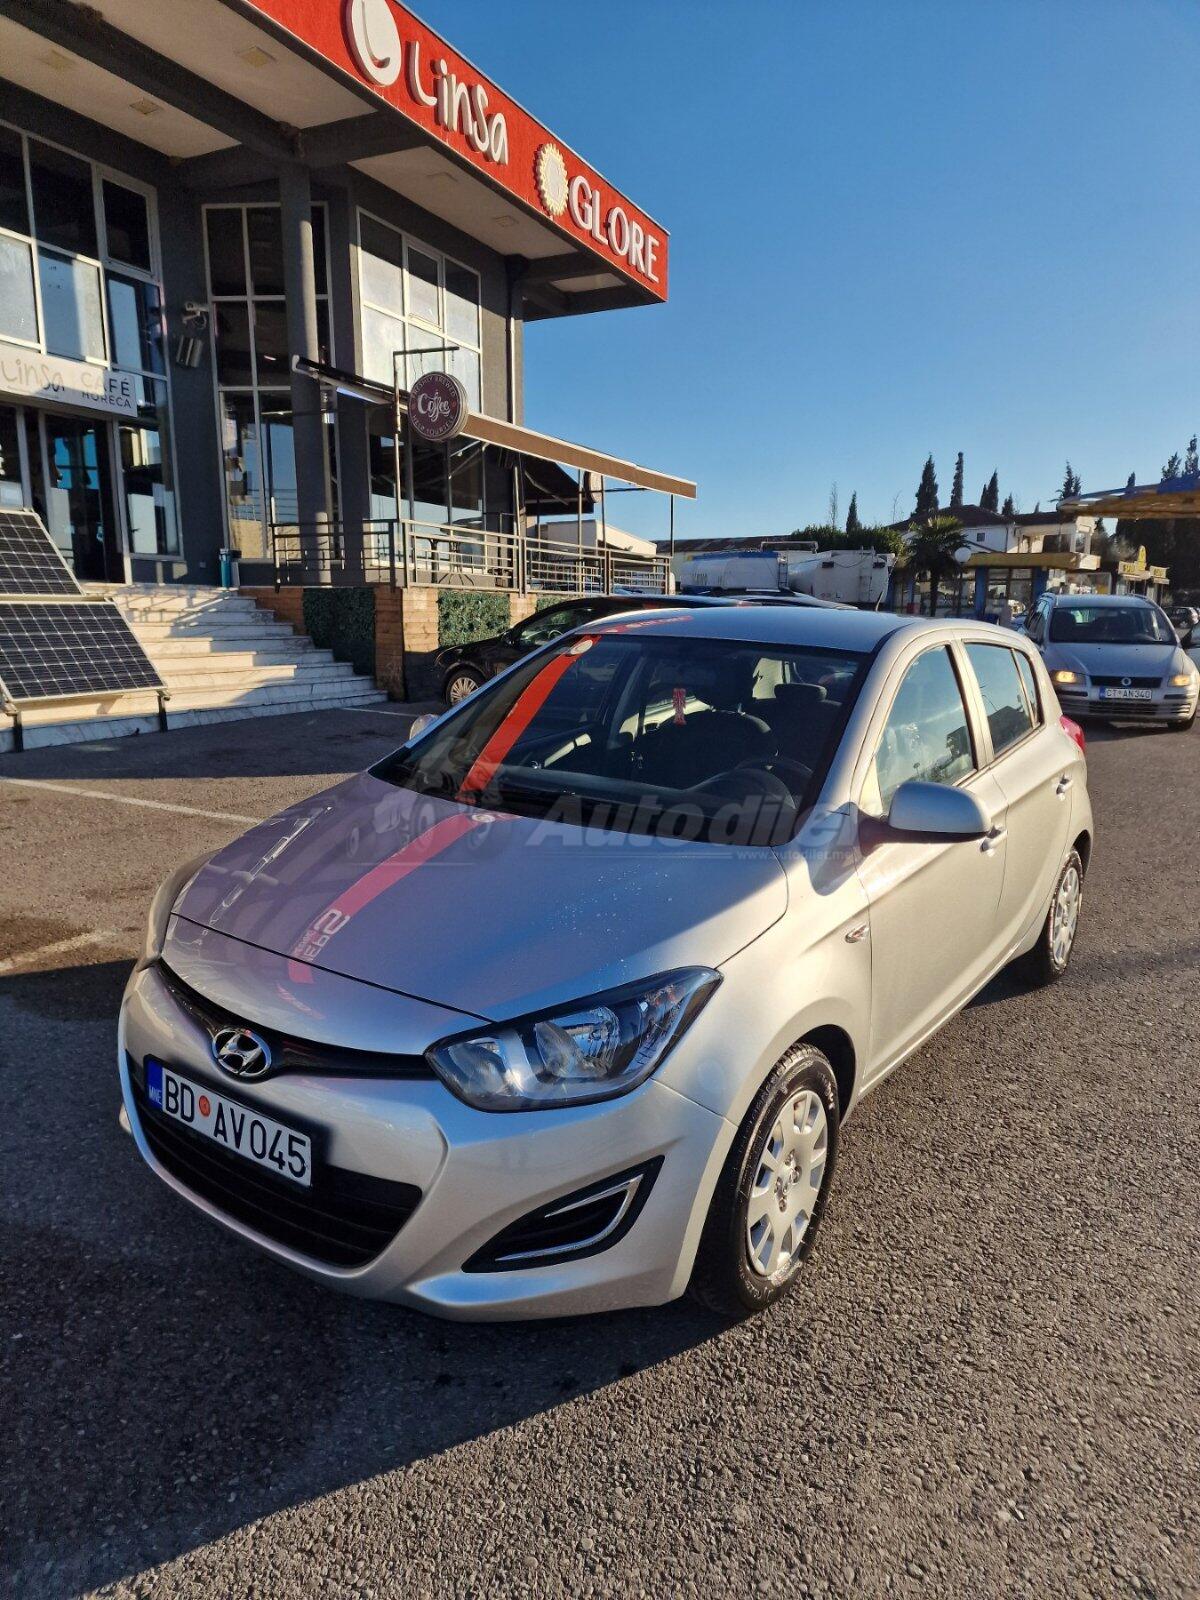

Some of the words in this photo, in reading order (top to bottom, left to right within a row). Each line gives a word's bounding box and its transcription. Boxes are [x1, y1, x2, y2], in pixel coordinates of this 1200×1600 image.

[570, 176, 660, 283] GLORE
[82, 391, 132, 409] HORECA
[418, 390, 451, 422] Coffee
[165, 1074, 195, 1123] BD
[213, 1102, 307, 1178] AV045
